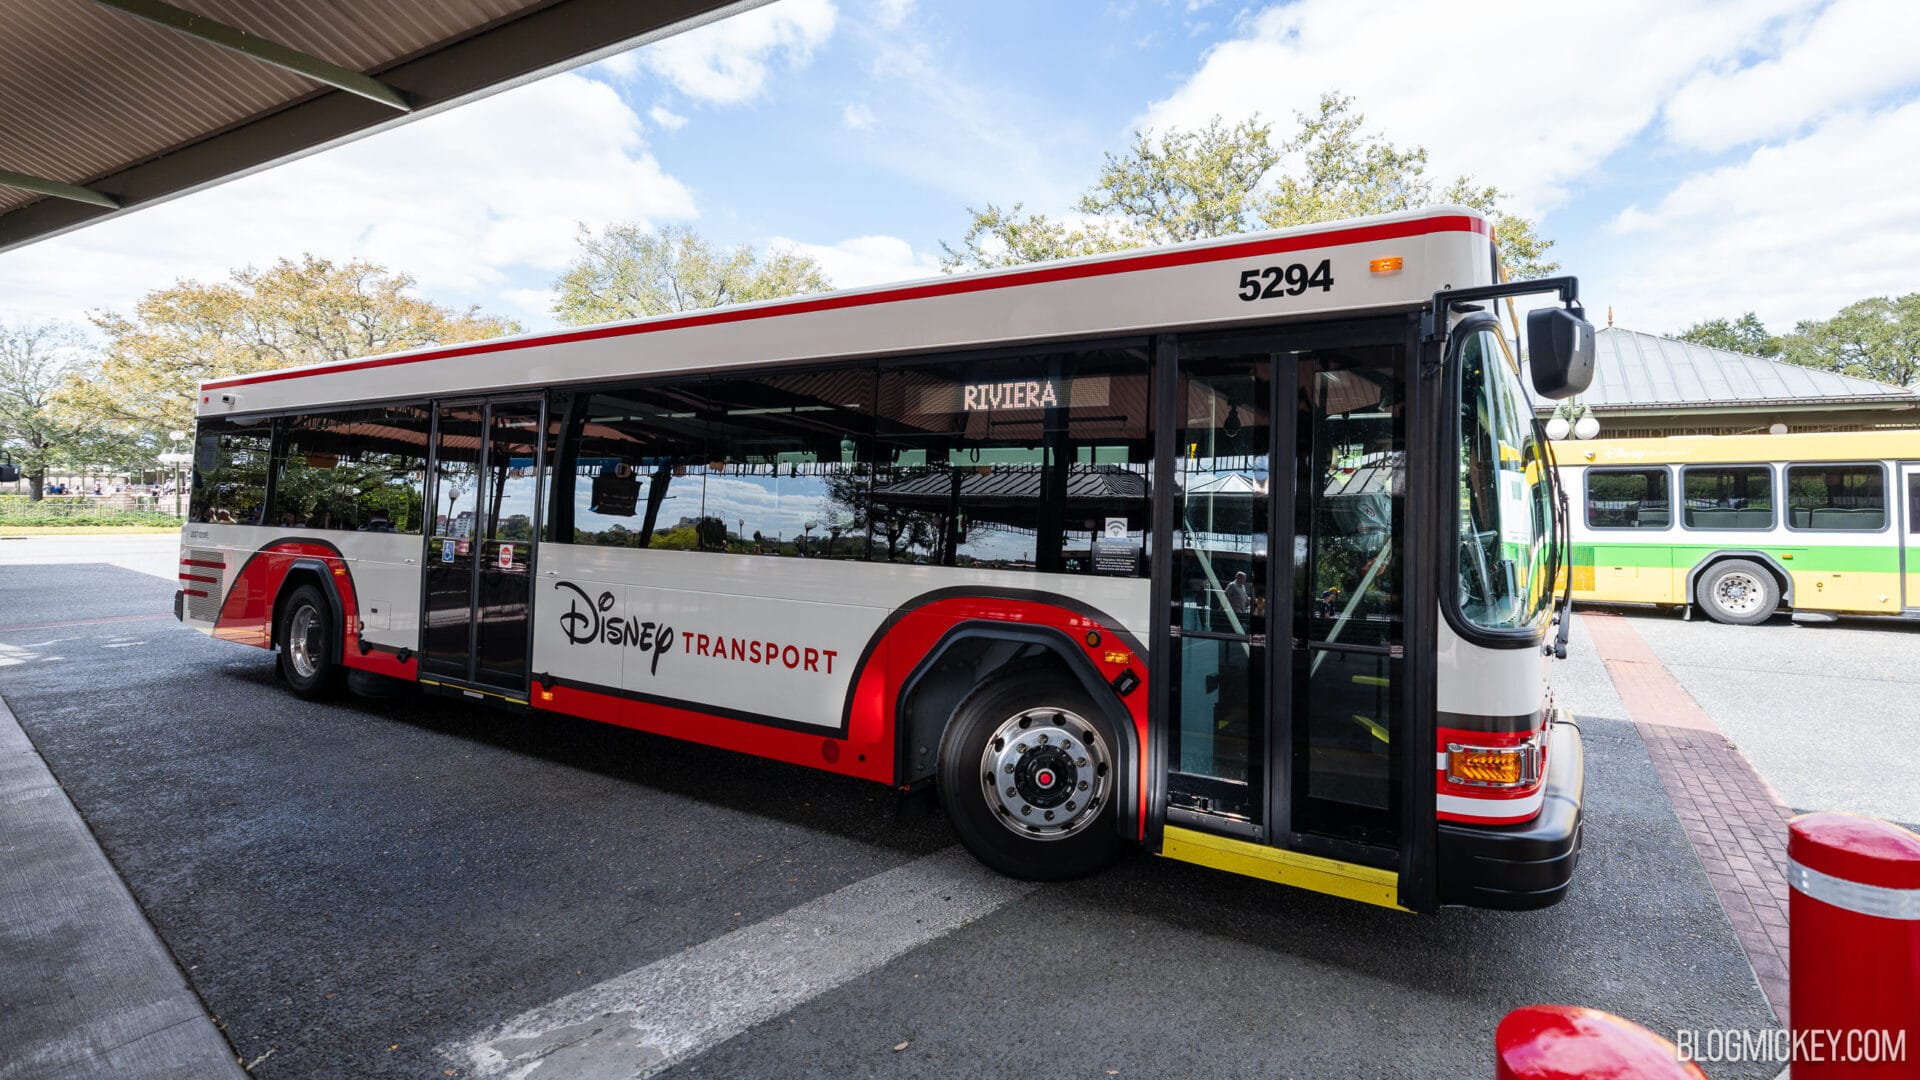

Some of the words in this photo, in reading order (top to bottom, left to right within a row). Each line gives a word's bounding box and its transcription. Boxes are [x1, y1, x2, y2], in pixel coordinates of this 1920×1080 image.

[1238, 258, 1334, 302] 5294
[964, 380, 1057, 411] RIVIERA
[682, 631, 838, 675] TRANSPORT
